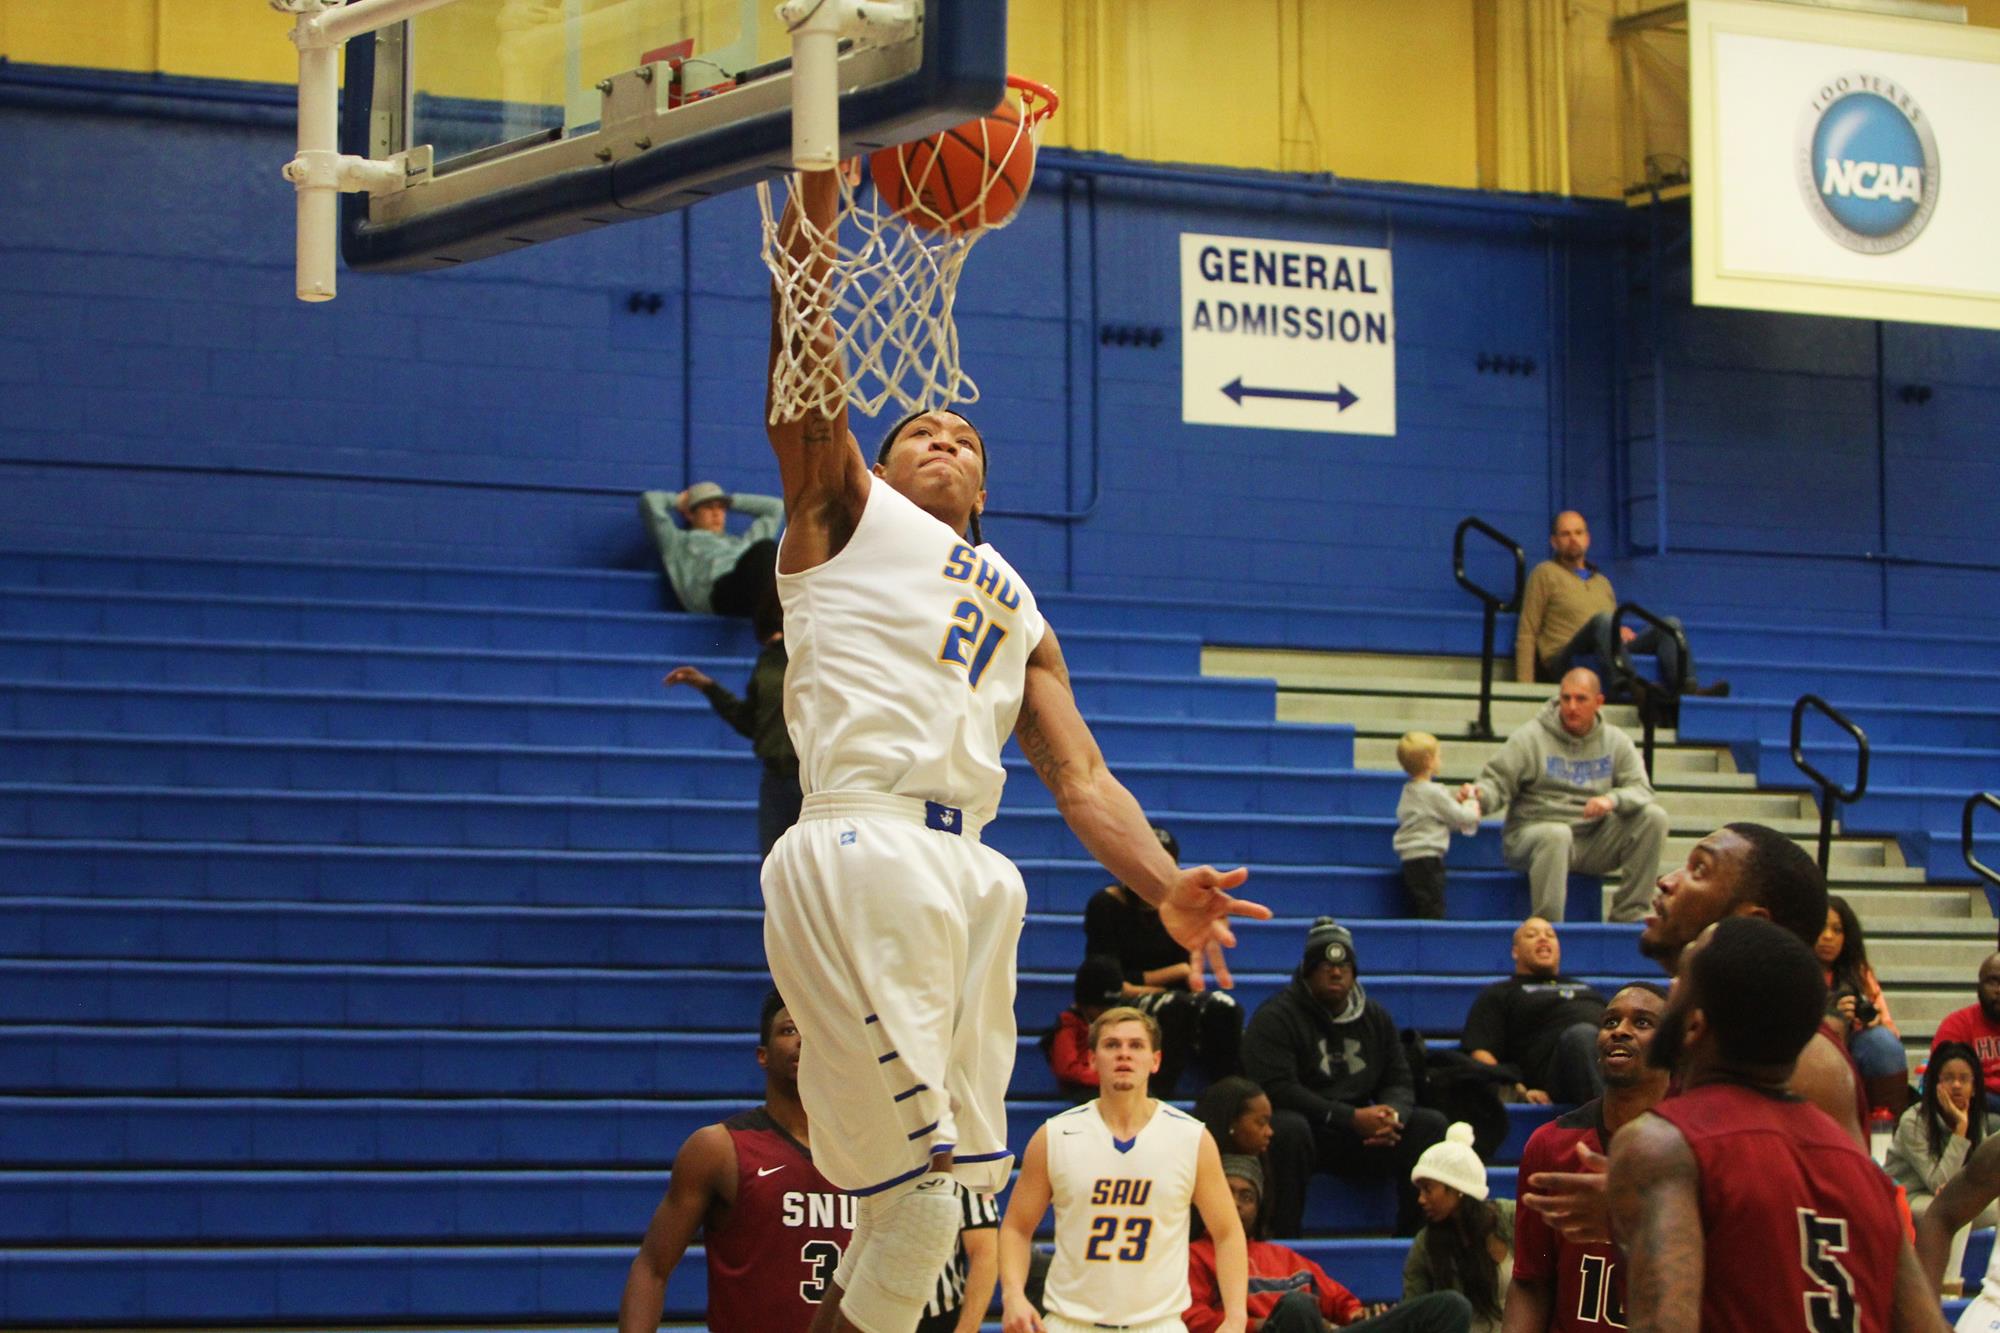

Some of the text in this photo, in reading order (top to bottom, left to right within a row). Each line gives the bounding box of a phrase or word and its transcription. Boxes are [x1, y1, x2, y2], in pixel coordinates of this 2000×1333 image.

[1812, 74, 1921, 123] 100 YEARS
[1822, 158, 1922, 203] NCAA
[1200, 246, 1378, 294] GENERAL
[1193, 299, 1387, 344] ADMISSION
[937, 598, 1008, 692] 21
[782, 1191, 858, 1230] SNU
[1090, 1178, 1152, 1206] SAU
[1084, 1215, 1153, 1263] 23
[800, 1240, 841, 1304] 3
[1796, 1206, 1861, 1333] 5
